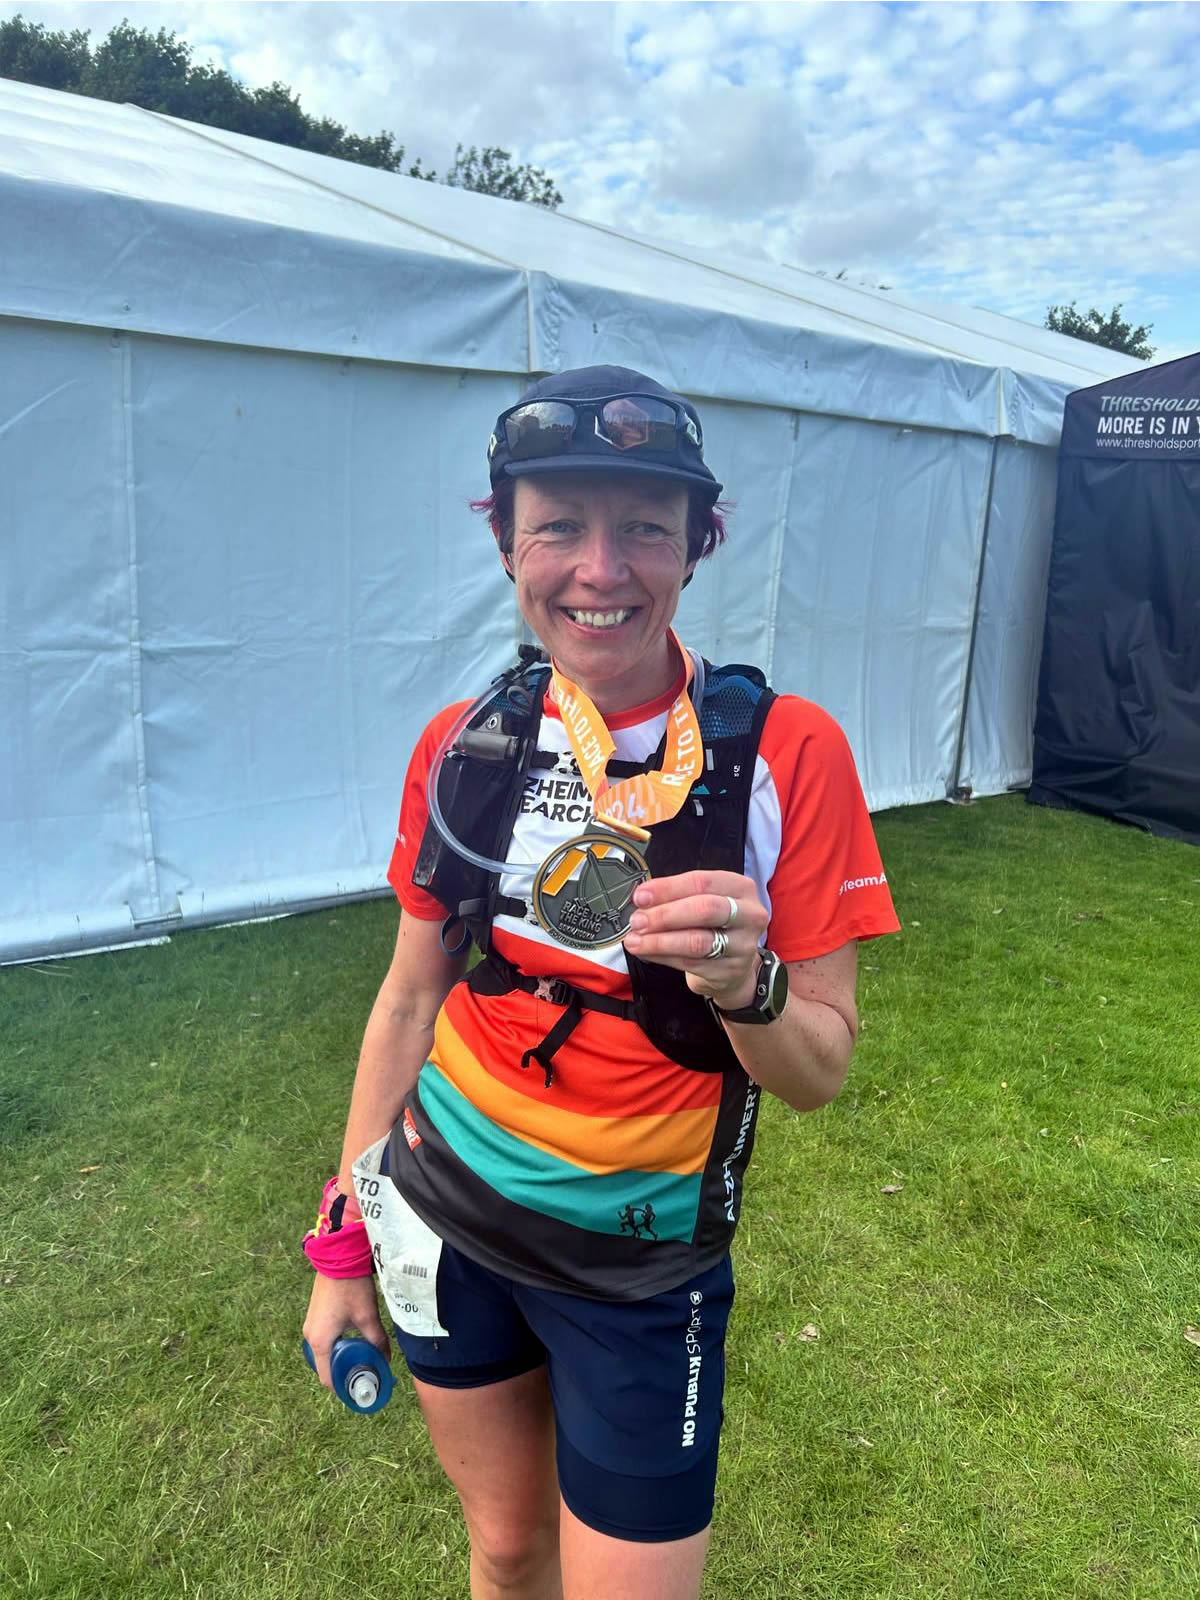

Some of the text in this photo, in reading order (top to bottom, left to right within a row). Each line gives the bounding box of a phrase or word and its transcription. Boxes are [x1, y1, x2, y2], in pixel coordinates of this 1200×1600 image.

[1097, 416, 1144, 434] MORE
[1149, 416, 1166, 435] IS
[1171, 416, 1190, 435] IN
[1096, 438, 1200, 451] www.thresholdspor
[677, 728, 696, 760] TO
[563, 900, 591, 918] RACE
[560, 909, 602, 933] THE KING
[360, 1177, 380, 1197] TO
[360, 1199, 382, 1220] NG
[682, 1308, 702, 1447] NO PUBLIK SPORT
